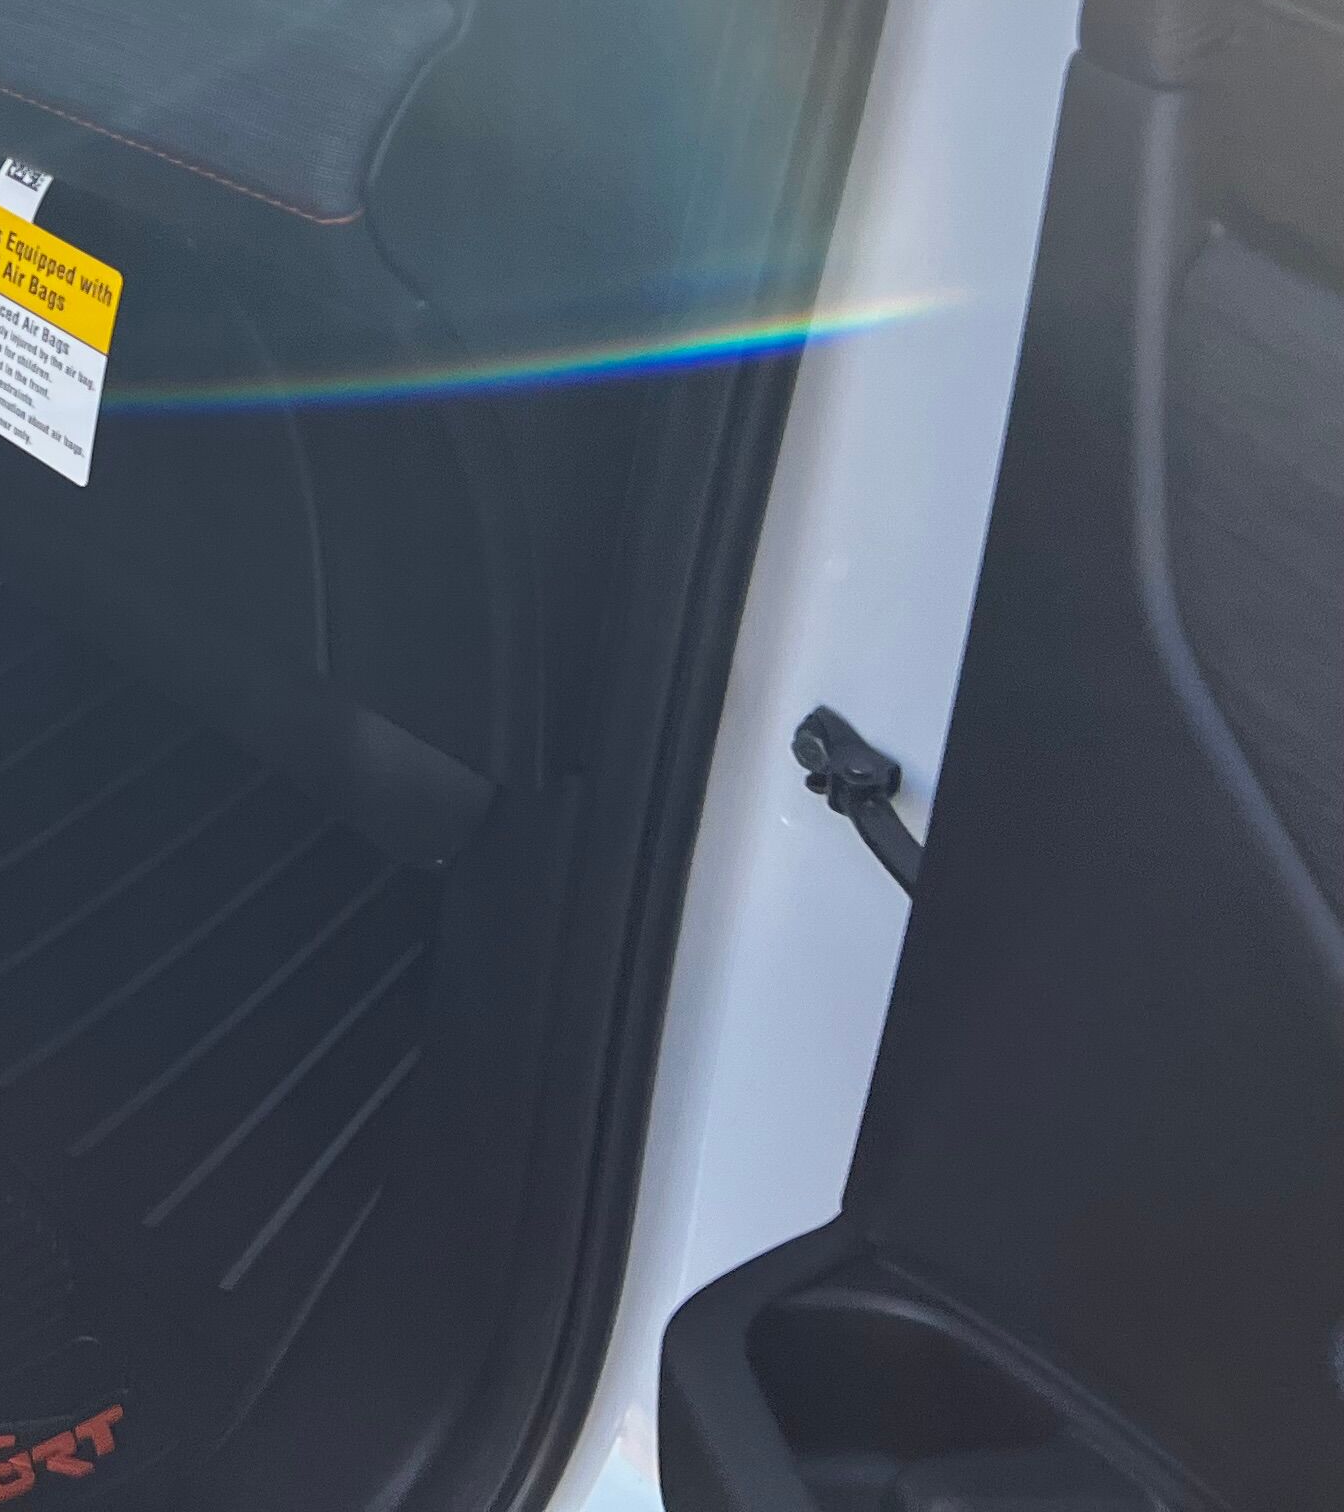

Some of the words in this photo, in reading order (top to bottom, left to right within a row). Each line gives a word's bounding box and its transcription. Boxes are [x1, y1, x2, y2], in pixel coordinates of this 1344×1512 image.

[2, 261, 25, 287] Air
[28, 274, 66, 311] Bags
[6, 230, 77, 286] Equipped
[80, 274, 113, 307] with
[22, 316, 39, 337] Air
[41, 326, 70, 356] Bags
